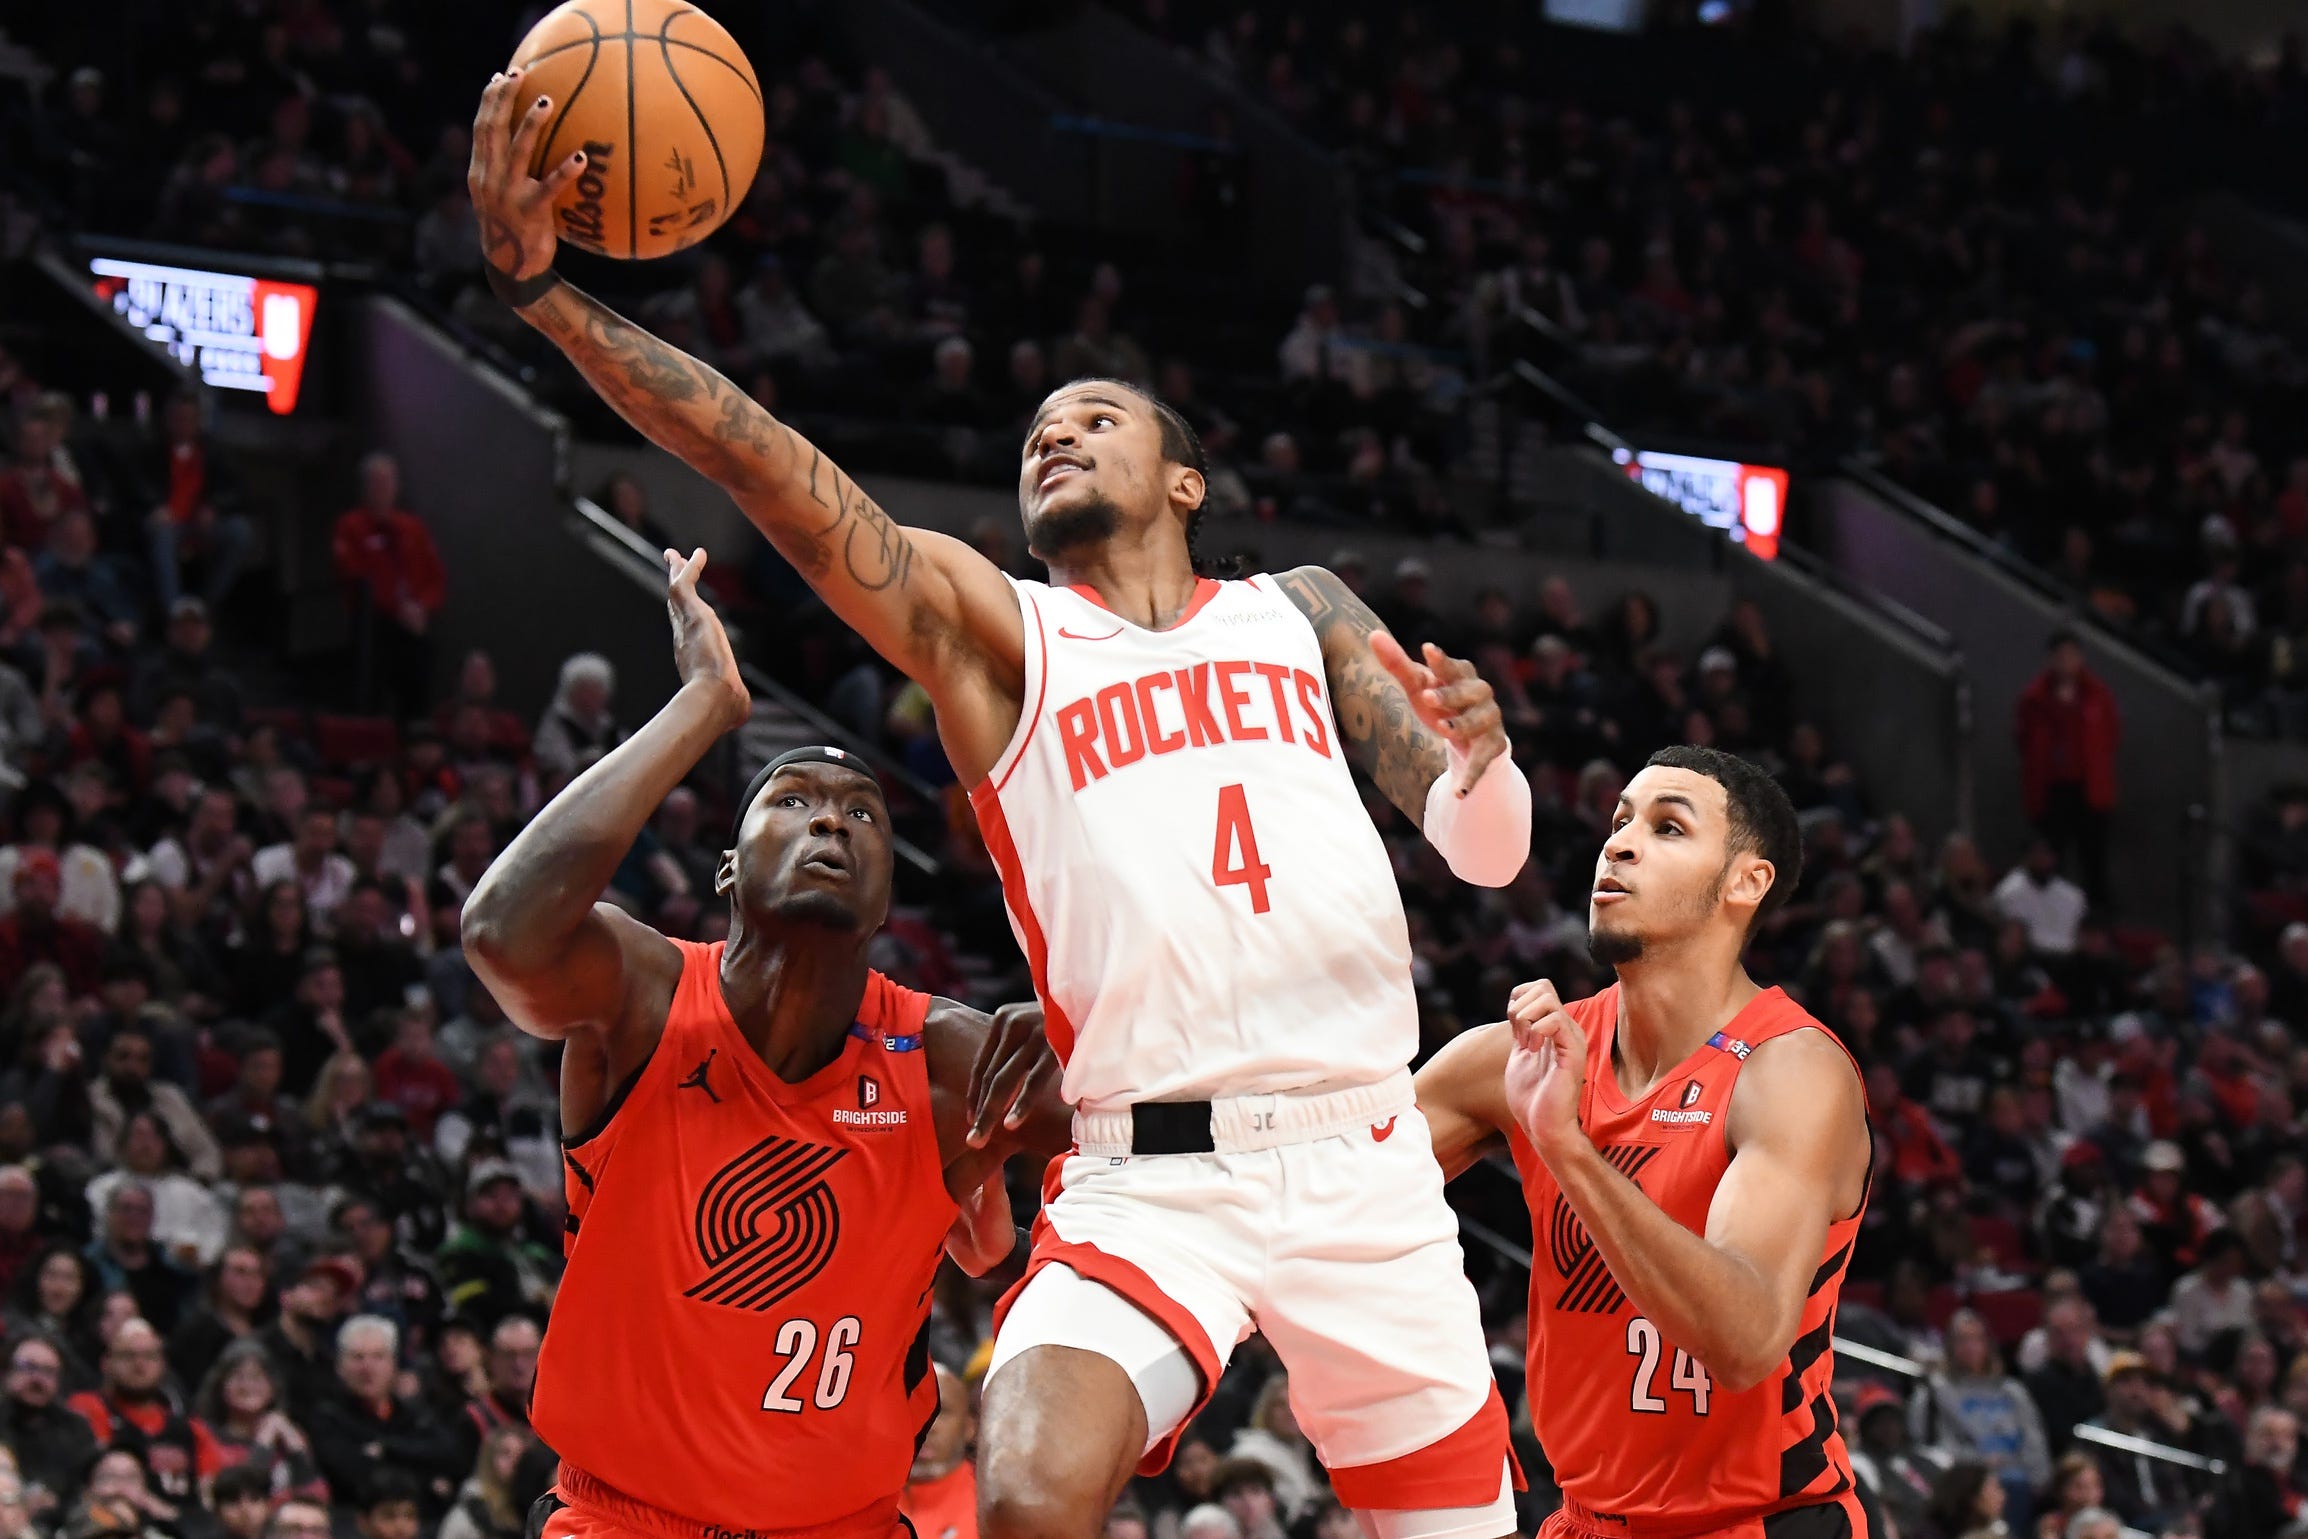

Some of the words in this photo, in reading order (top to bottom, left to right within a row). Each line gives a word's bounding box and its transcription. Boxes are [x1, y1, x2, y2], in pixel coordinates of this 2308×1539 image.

[1055, 660, 1333, 793] ROCKETS
[1212, 783, 1272, 914] 4
[833, 1109, 907, 1124] BRIGHTSIDE
[1651, 1108, 1712, 1124] BRIGHTSIDE
[761, 1315, 862, 1414] 26
[1626, 1316, 1711, 1416] 24
